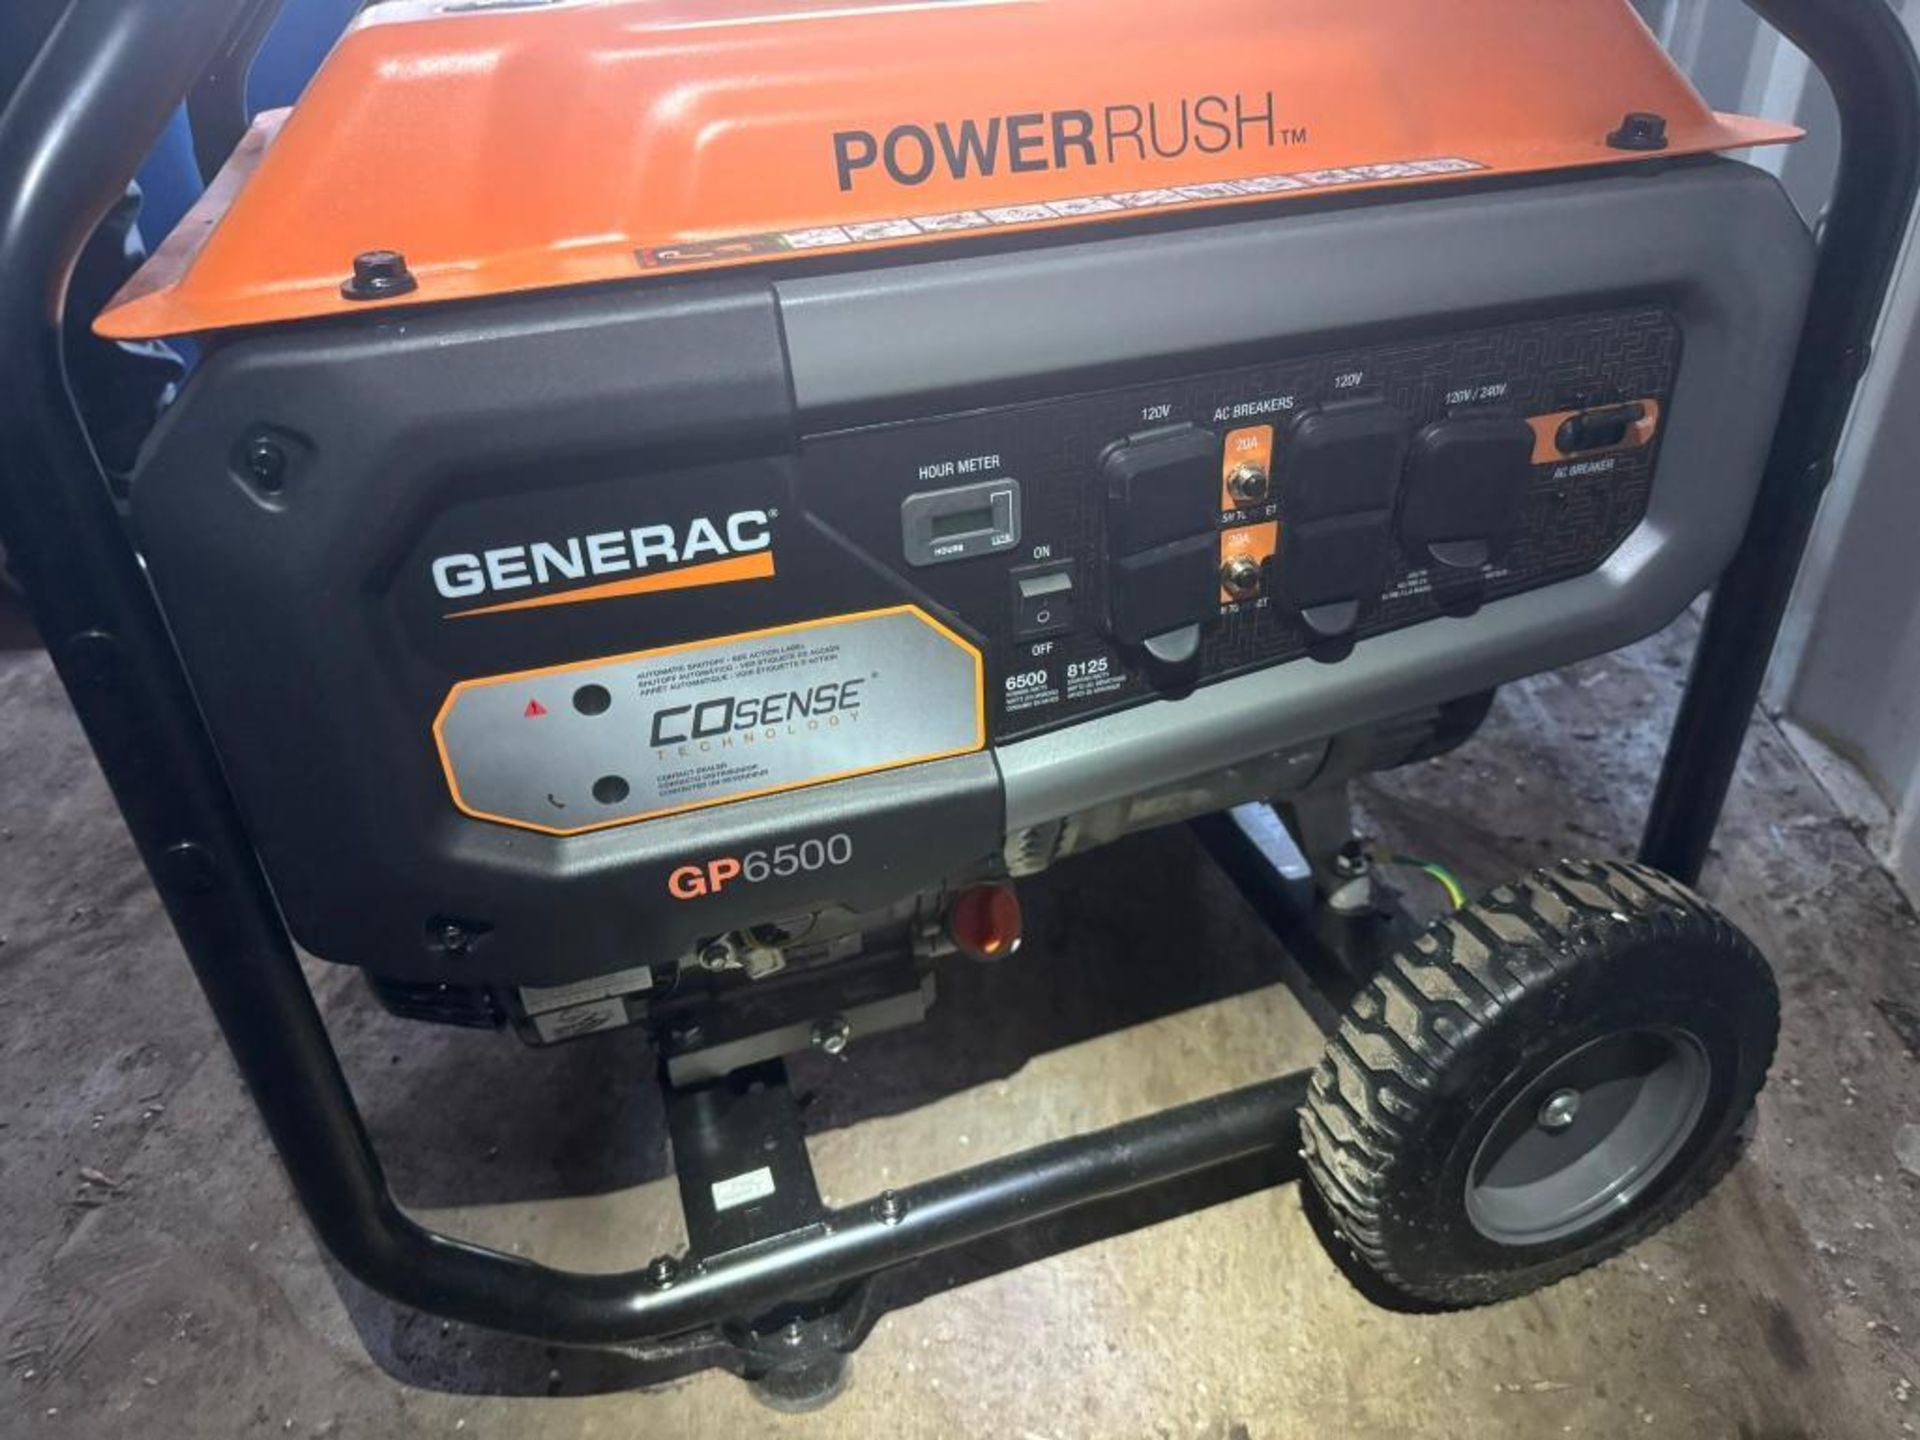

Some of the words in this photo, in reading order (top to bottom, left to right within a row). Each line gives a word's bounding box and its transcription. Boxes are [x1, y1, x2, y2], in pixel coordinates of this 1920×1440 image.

[1141, 404, 1172, 421] 120V
[1213, 408, 1230, 422] AC
[1233, 396, 1294, 417] BREAKERS
[919, 461, 954, 480] HOUR
[958, 455, 1000, 474] METER
[1033, 545, 1051, 560] ON
[1032, 641, 1054, 656] OFF
[1066, 657, 1109, 678] 8125
[1005, 670, 1048, 690] 6500
[668, 833, 853, 900] GP6500
